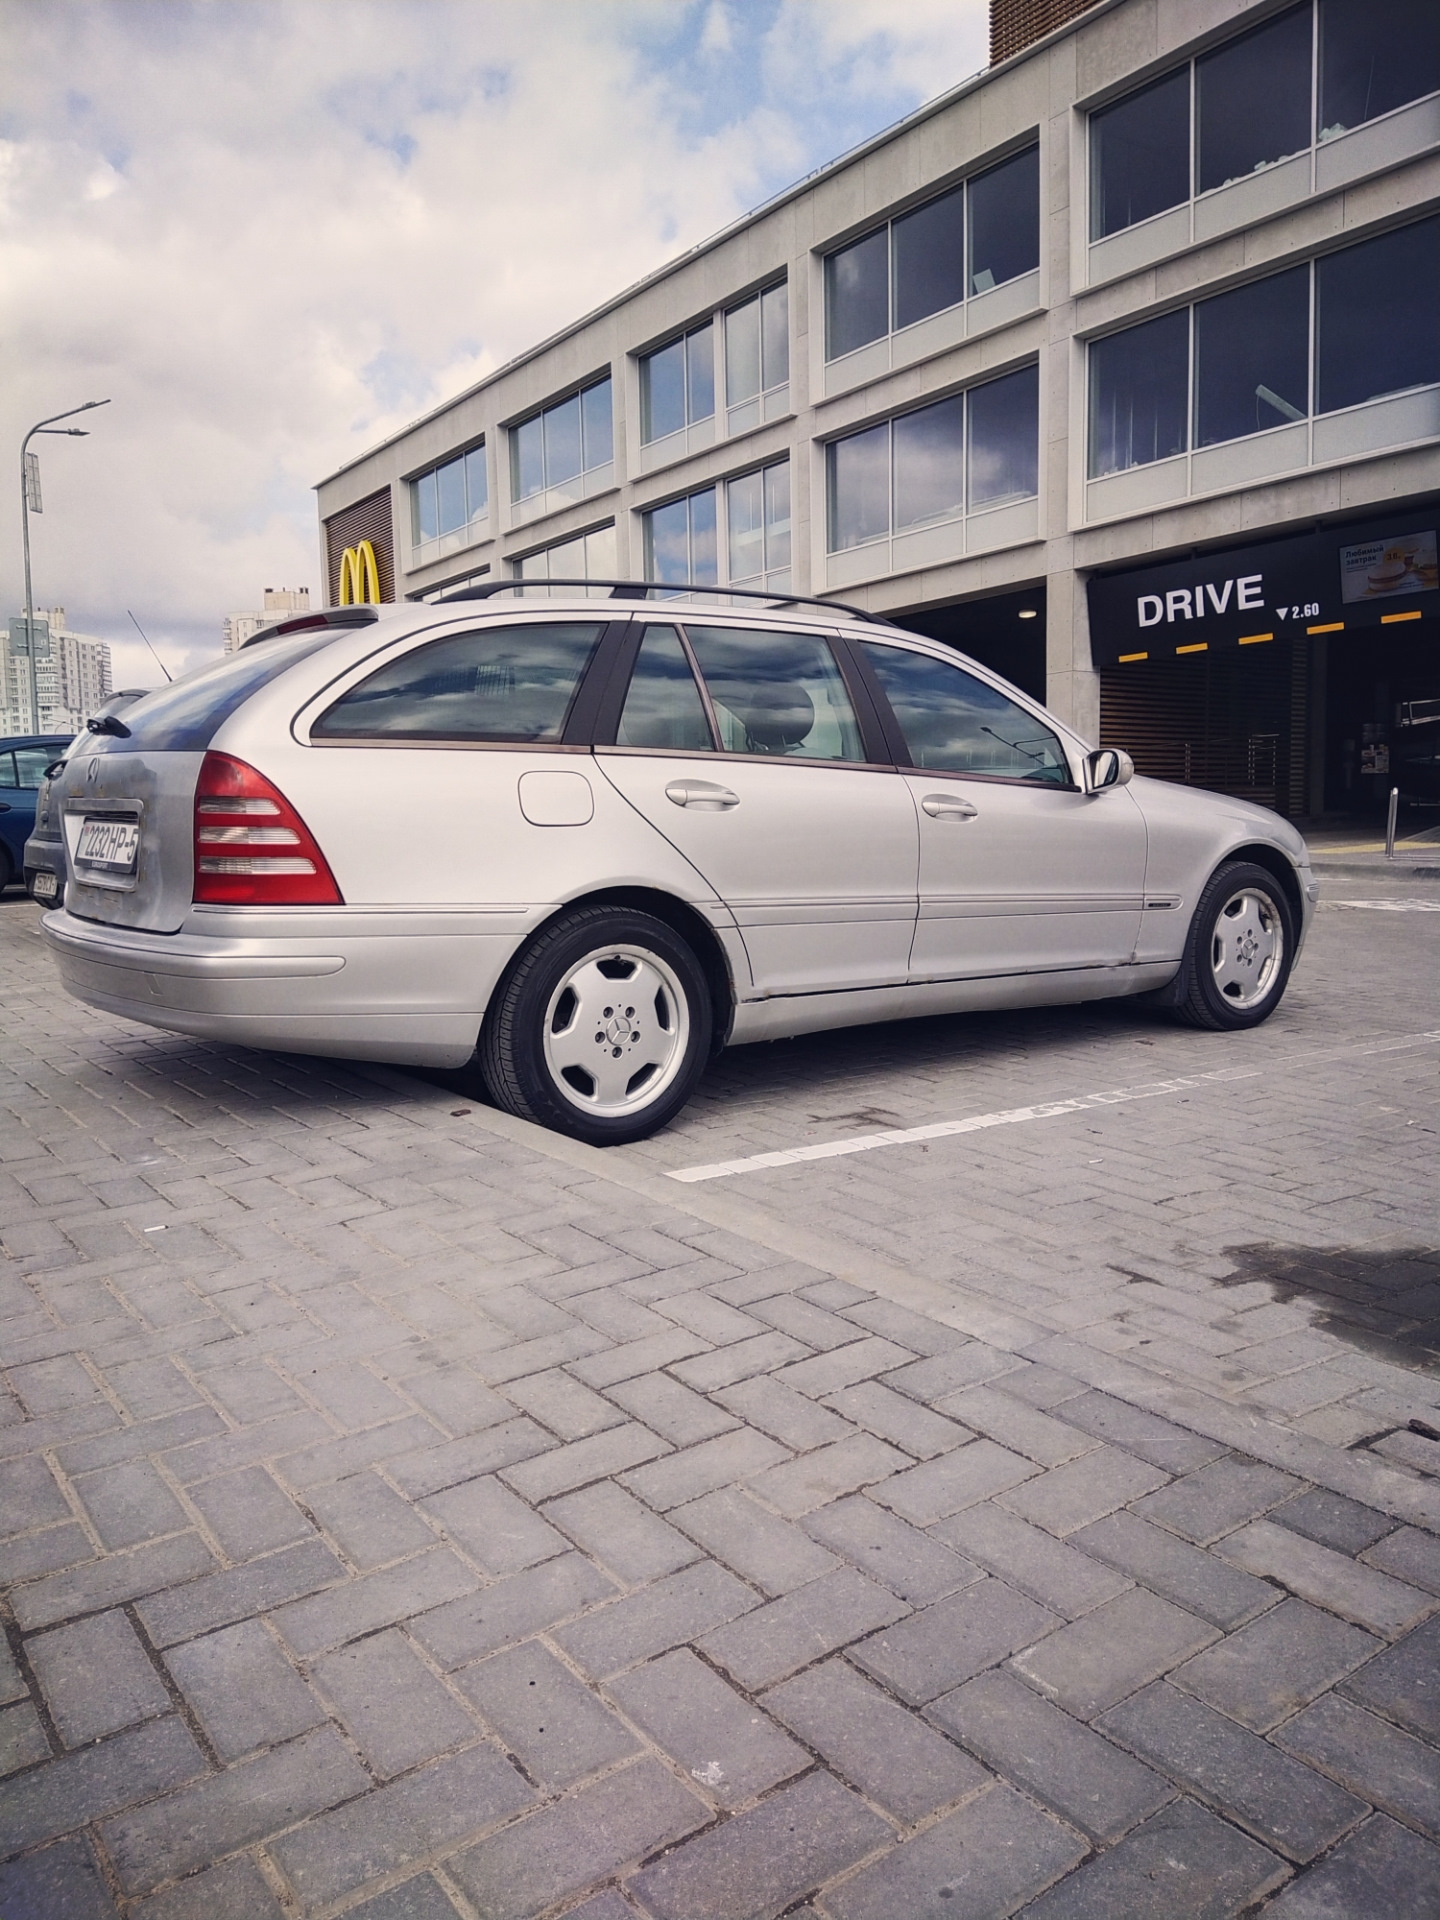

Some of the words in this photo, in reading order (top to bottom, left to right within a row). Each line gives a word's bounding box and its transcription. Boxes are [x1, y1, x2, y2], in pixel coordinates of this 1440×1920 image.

[1345, 544, 1384, 558] Любимый
[1345, 555, 1377, 566] завтрак
[1137, 574, 1264, 627] DRIVE
[1292, 602, 1320, 619] 2.60
